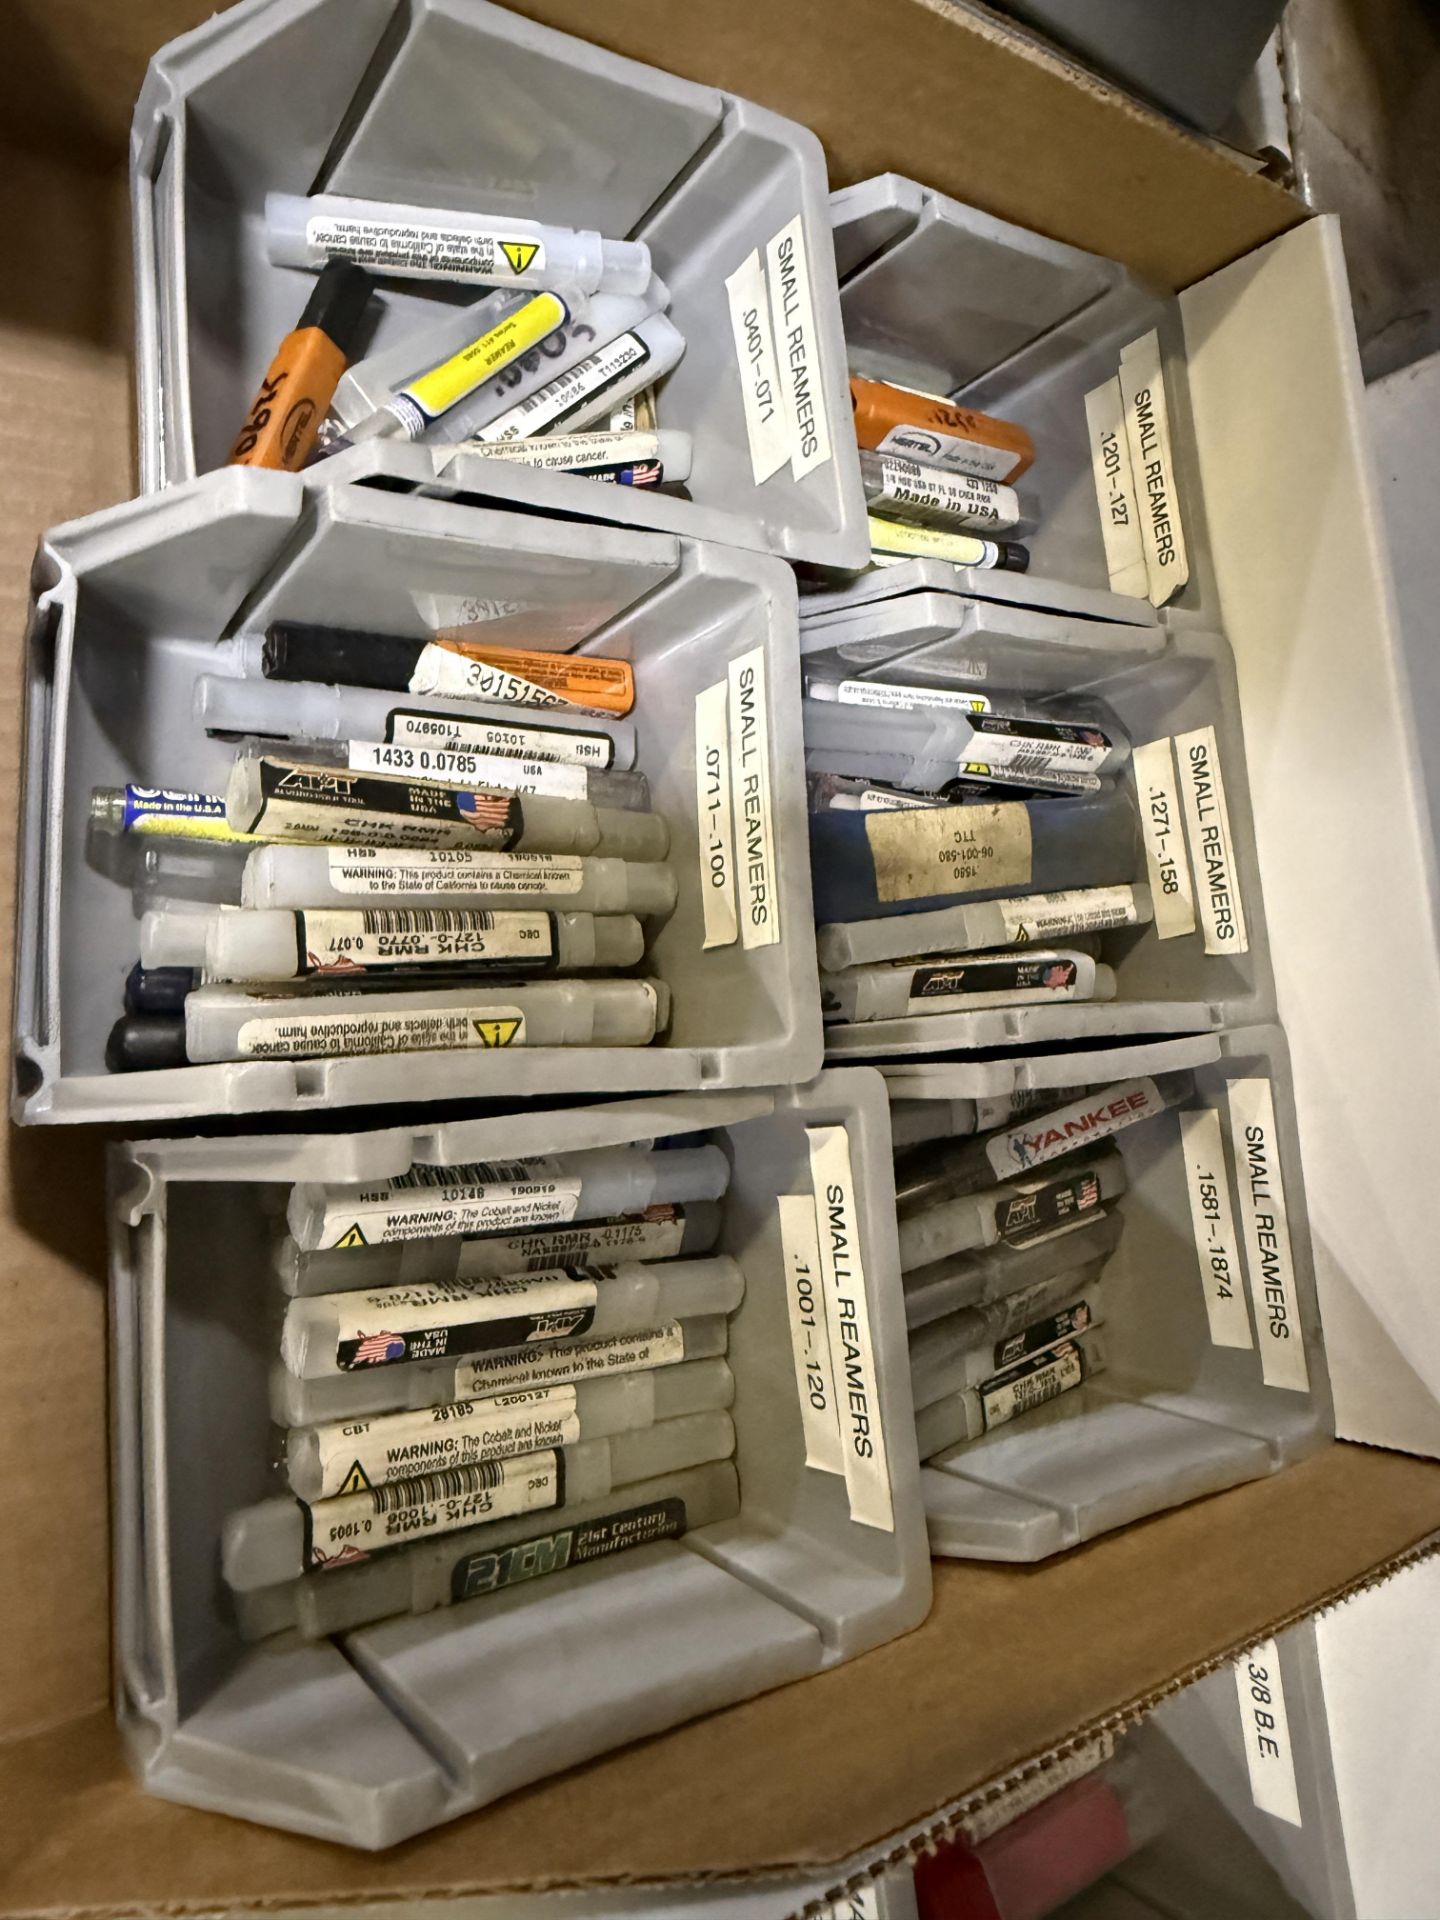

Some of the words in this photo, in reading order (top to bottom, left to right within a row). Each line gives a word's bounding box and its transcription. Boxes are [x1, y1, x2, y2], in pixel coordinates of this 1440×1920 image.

[775, 236, 803, 324] SMALL
[787, 323, 820, 457] REAMERS
[1136, 388, 1158, 453] SMALL
[1149, 460, 1174, 567] REAMERS
[892, 486, 941, 508] Made
[944, 497, 962, 512] in
[966, 502, 1001, 520] USA
[736, 666, 759, 769] SMALL
[371, 746, 414, 768] 1433
[419, 750, 478, 773] 0.0785
[522, 763, 543, 776] USA
[1186, 743, 1217, 822] SMALL
[132, 799, 162, 811] Made
[175, 802, 192, 811] the
[741, 772, 769, 927] REAMERS
[953, 829, 976, 843] TTC
[341, 867, 397, 881] WARNING:
[399, 868, 420, 880] This
[421, 868, 453, 883] product
[381, 880, 396, 891] the
[397, 879, 423, 891] State
[1199, 824, 1235, 942] REAMERS
[328, 934, 363, 951] 0.077
[376, 944, 429, 956] RMR
[436, 941, 485, 954] CHK
[1028, 1090, 1149, 1153] YANKEE
[1241, 1123, 1274, 1207] SMALL
[385, 1209, 457, 1228] WARNING:
[460, 1207, 479, 1220] The
[481, 1204, 511, 1218] Cobalt
[513, 1202, 532, 1214] and
[532, 1200, 561, 1213] Nickel
[506, 1235, 545, 1250] CHK
[827, 1186, 853, 1287] SMALL
[1252, 1211, 1290, 1341] REAMERS
[423, 1327, 449, 1339] USA
[429, 1336, 448, 1347] IN
[410, 1344, 447, 1358] MADE
[548, 1345, 572, 1359] This
[585, 1356, 605, 1370] the
[606, 1349, 636, 1366] State
[637, 1346, 650, 1359] of
[835, 1297, 873, 1459] REAMERS
[341, 1421, 371, 1437] CBT
[385, 1437, 460, 1463] WARNING:
[461, 1433, 481, 1448] The
[481, 1427, 513, 1445] Cobalt
[512, 1423, 531, 1438] and
[460, 1449, 478, 1463] this
[383, 1513, 439, 1536] RMR
[444, 1501, 494, 1521] CHK
[573, 1520, 681, 1560] Manufacturing
[576, 1528, 607, 1546] 21st
[609, 1511, 668, 1537] Century
[1245, 1660, 1273, 1707] 3/8
[1251, 1705, 1281, 1761] B.E.
